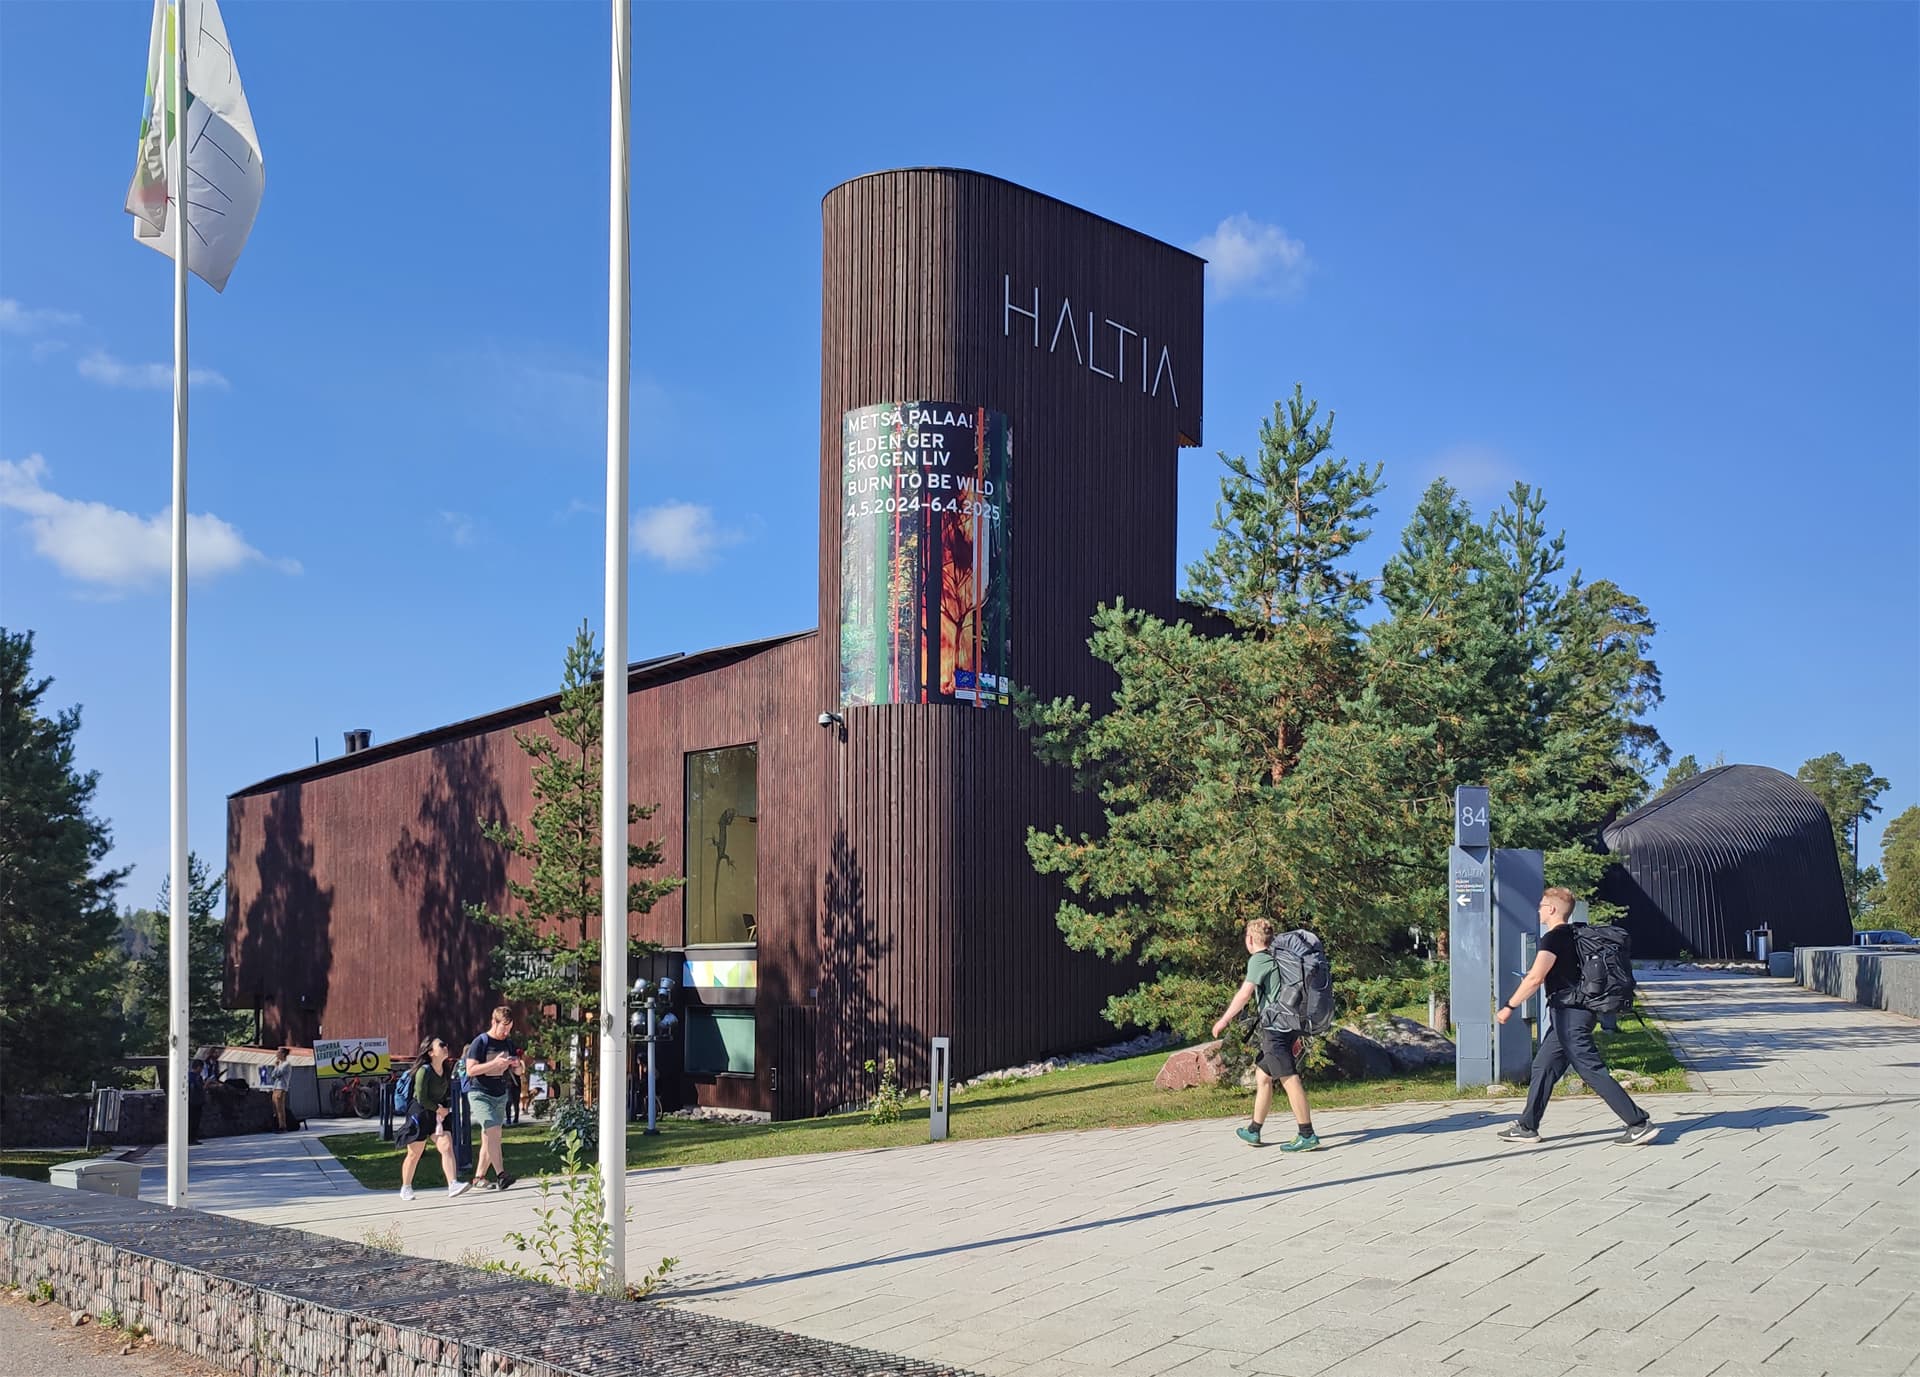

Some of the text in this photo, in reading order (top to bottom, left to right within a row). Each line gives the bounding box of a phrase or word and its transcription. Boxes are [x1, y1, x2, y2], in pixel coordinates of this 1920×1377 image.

[1005, 274, 1179, 408] HALTIA
[848, 407, 974, 433] METSÄ PALAA!
[848, 433, 944, 457] ELDEN GER
[848, 451, 951, 474] SKOGEN LIV
[848, 474, 994, 496] BURN TO BE WILD
[1462, 806, 1487, 827] 84
